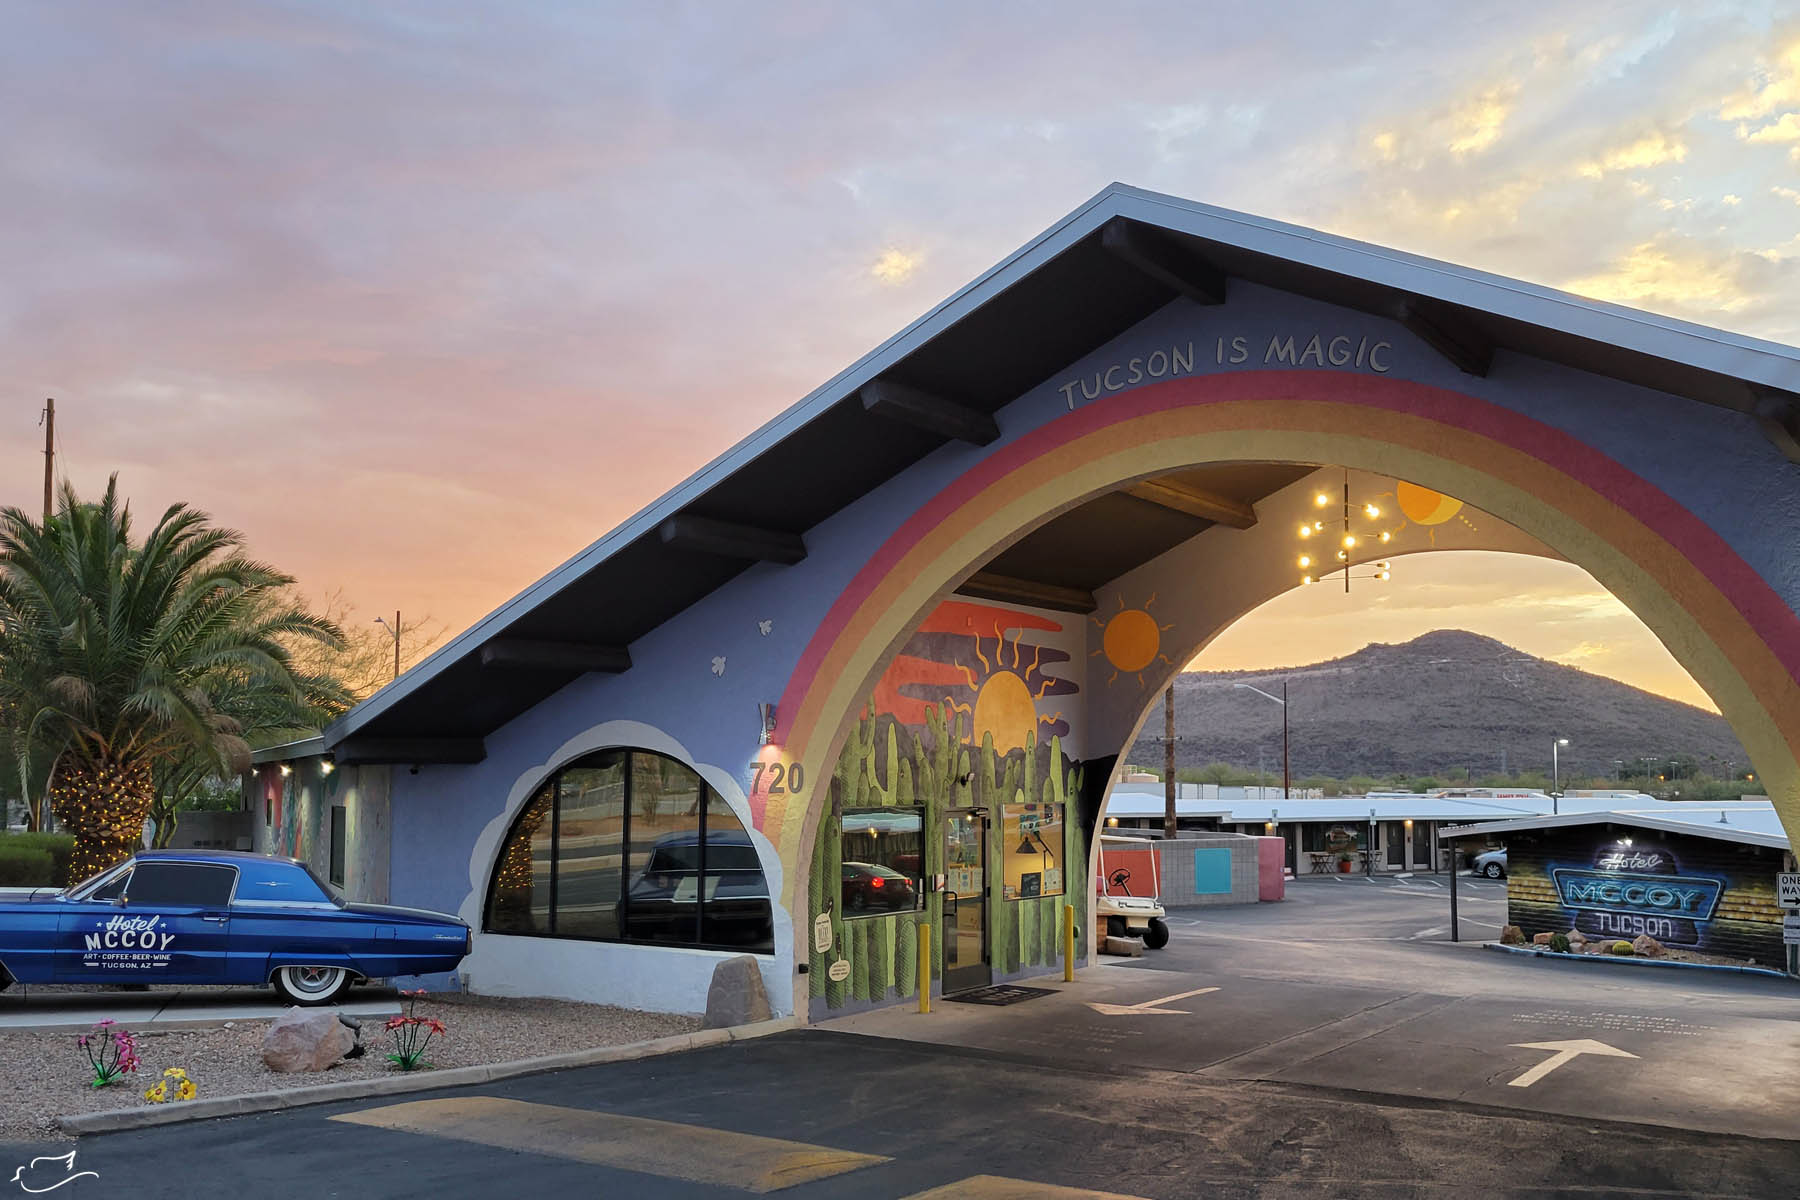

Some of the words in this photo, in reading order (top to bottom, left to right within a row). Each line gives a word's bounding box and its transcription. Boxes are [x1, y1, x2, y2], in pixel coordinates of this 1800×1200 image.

[1058, 341, 1194, 411] TUCSON
[1216, 336, 1249, 364] IS
[1264, 334, 1393, 372] MAGIC
[749, 762, 804, 795] 720
[1567, 880, 1701, 911] MCCOY
[106, 914, 160, 931] Hotel
[84, 930, 175, 951] MCCOY
[153, 953, 172, 961] WINE
